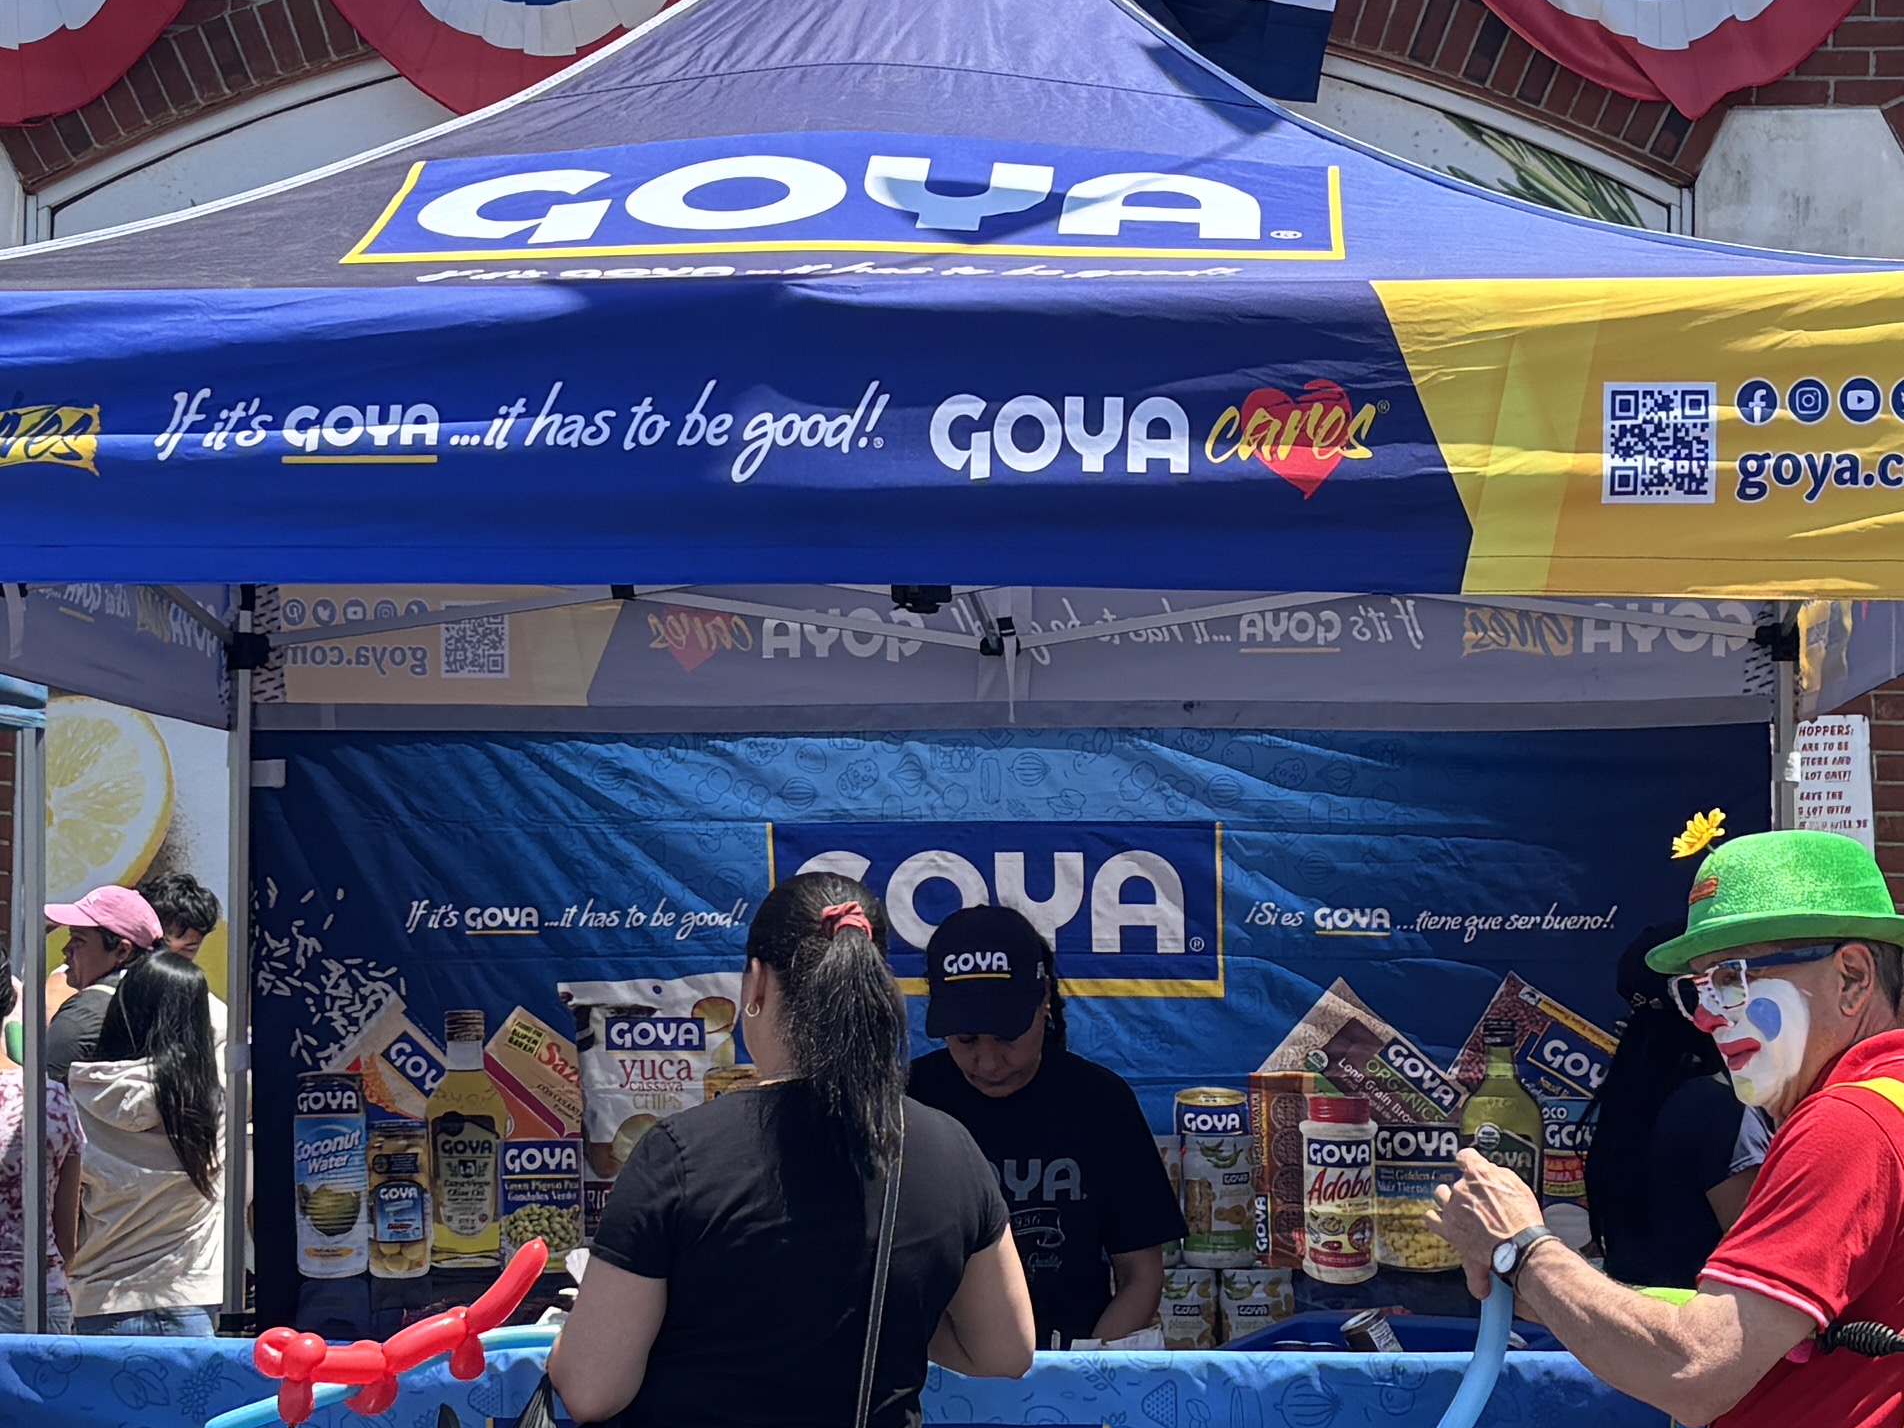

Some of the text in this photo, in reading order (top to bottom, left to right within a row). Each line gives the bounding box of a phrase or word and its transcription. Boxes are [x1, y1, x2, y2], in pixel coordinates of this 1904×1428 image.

[417, 154, 1261, 245] GOYA
[155, 388, 208, 458] If
[204, 399, 267, 451] it's
[282, 403, 439, 450] GOYA
[524, 384, 614, 450] has
[625, 395, 673, 450] to
[680, 381, 731, 449] be
[732, 381, 891, 483] good!
[930, 394, 1374, 479] GOYA cares
[405, 899, 430, 934] If
[428, 904, 460, 929] it's
[464, 907, 539, 930] GOYA
[579, 898, 621, 928] has
[625, 903, 648, 928] to
[649, 897, 676, 928] be
[675, 897, 749, 941] good!
[1313, 907, 1391, 932] GOYA
[1464, 914, 1503, 943] que
[1504, 913, 1540, 930] ser
[943, 951, 1010, 974] GOYA
[611, 1022, 700, 1048] GOYA
[389, 1041, 446, 1092] GOY
[618, 1058, 696, 1089] yuca
[1387, 1044, 1456, 1109] GOYA
[1543, 1038, 1609, 1089] GOY
[629, 1080, 685, 1092] cassava
[1337, 1057, 1392, 1107] Long Grain
[297, 1090, 359, 1113] GOYA
[1183, 1113, 1241, 1132] GOYA
[295, 1129, 362, 1158] Coconut
[441, 1139, 493, 1155] GOYA
[1308, 1143, 1371, 1165] GOYA
[1376, 1130, 1458, 1160] GOYA
[306, 1152, 351, 1175] Water
[505, 1146, 578, 1173] GOYA
[378, 1186, 419, 1201] GOYA
[992, 1157, 1083, 1202] YA
[1306, 1167, 1371, 1206] Adobo
[1254, 1195, 1267, 1252] GOYA
